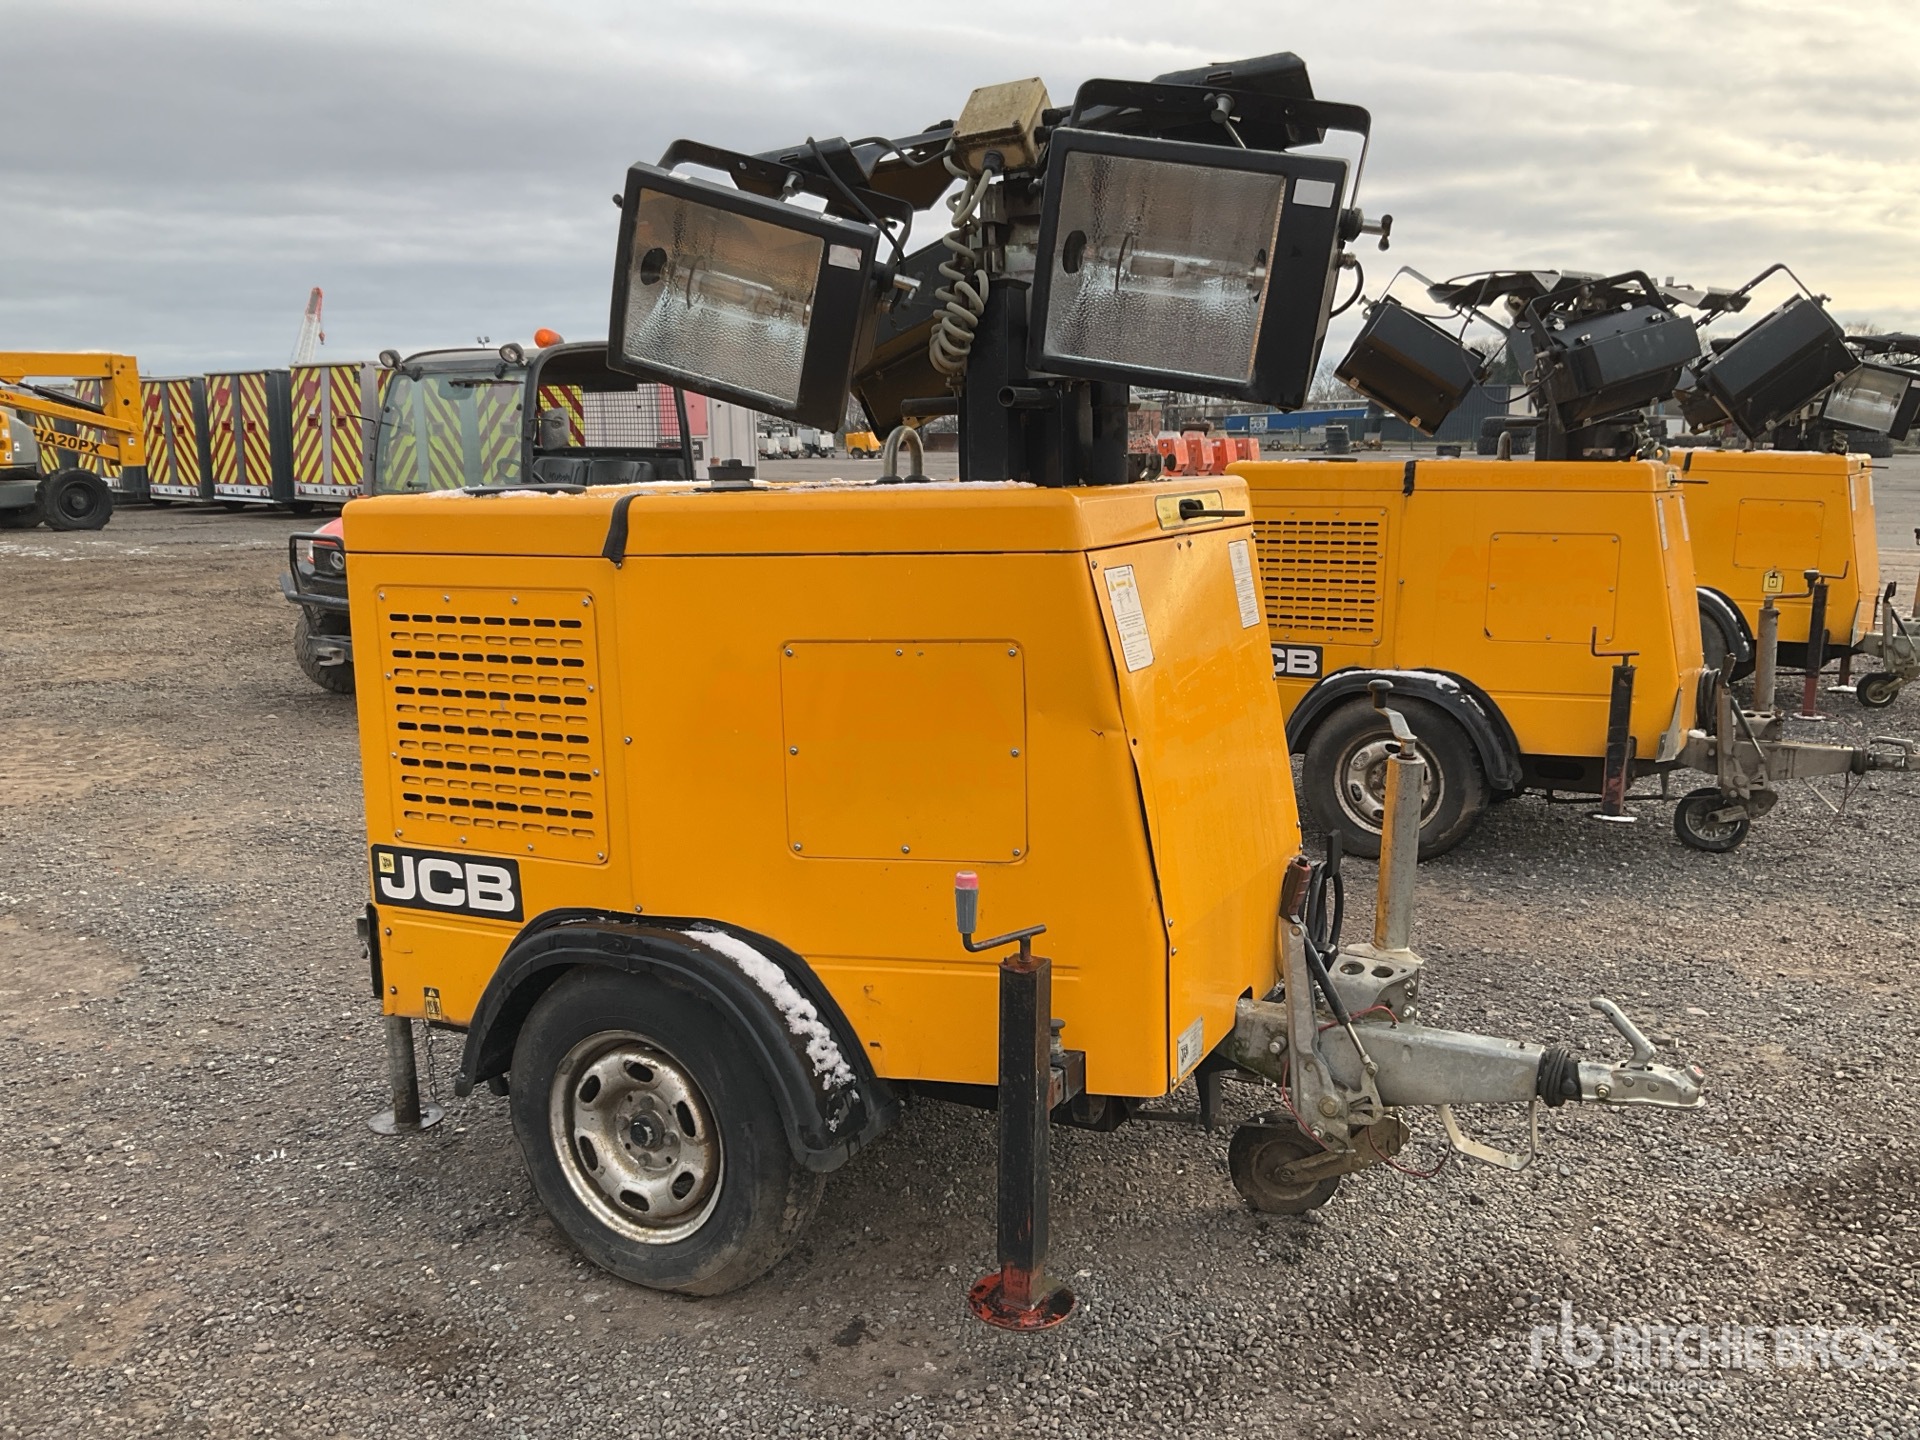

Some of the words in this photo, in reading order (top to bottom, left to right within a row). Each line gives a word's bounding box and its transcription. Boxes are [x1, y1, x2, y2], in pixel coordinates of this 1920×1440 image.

[33, 429, 101, 454] HA20PX
[1271, 647, 1318, 675] CB
[380, 855, 515, 912] JCB
